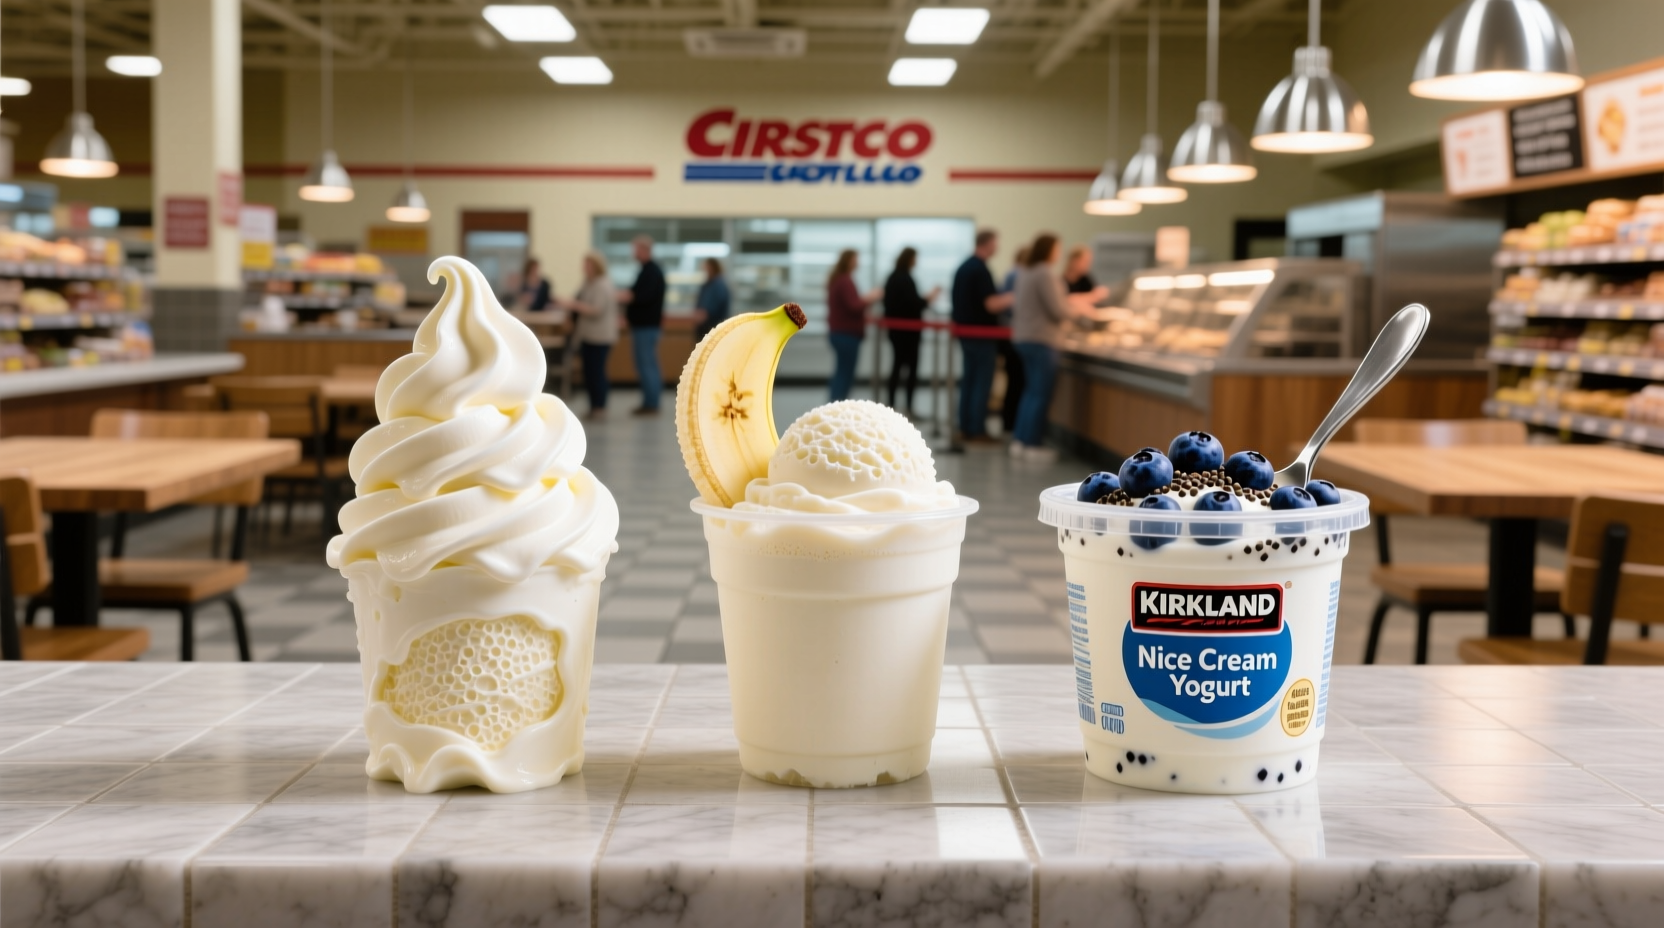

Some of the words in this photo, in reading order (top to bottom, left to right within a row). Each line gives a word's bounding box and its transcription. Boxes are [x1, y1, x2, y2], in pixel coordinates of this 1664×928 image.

[685, 108, 934, 160] CIRSTCO
[1140, 590, 1276, 617] KIRKLAND
[1138, 644, 1192, 671] Nice
[1198, 647, 1277, 672] Cream
[1169, 674, 1252, 704] Yogurt
